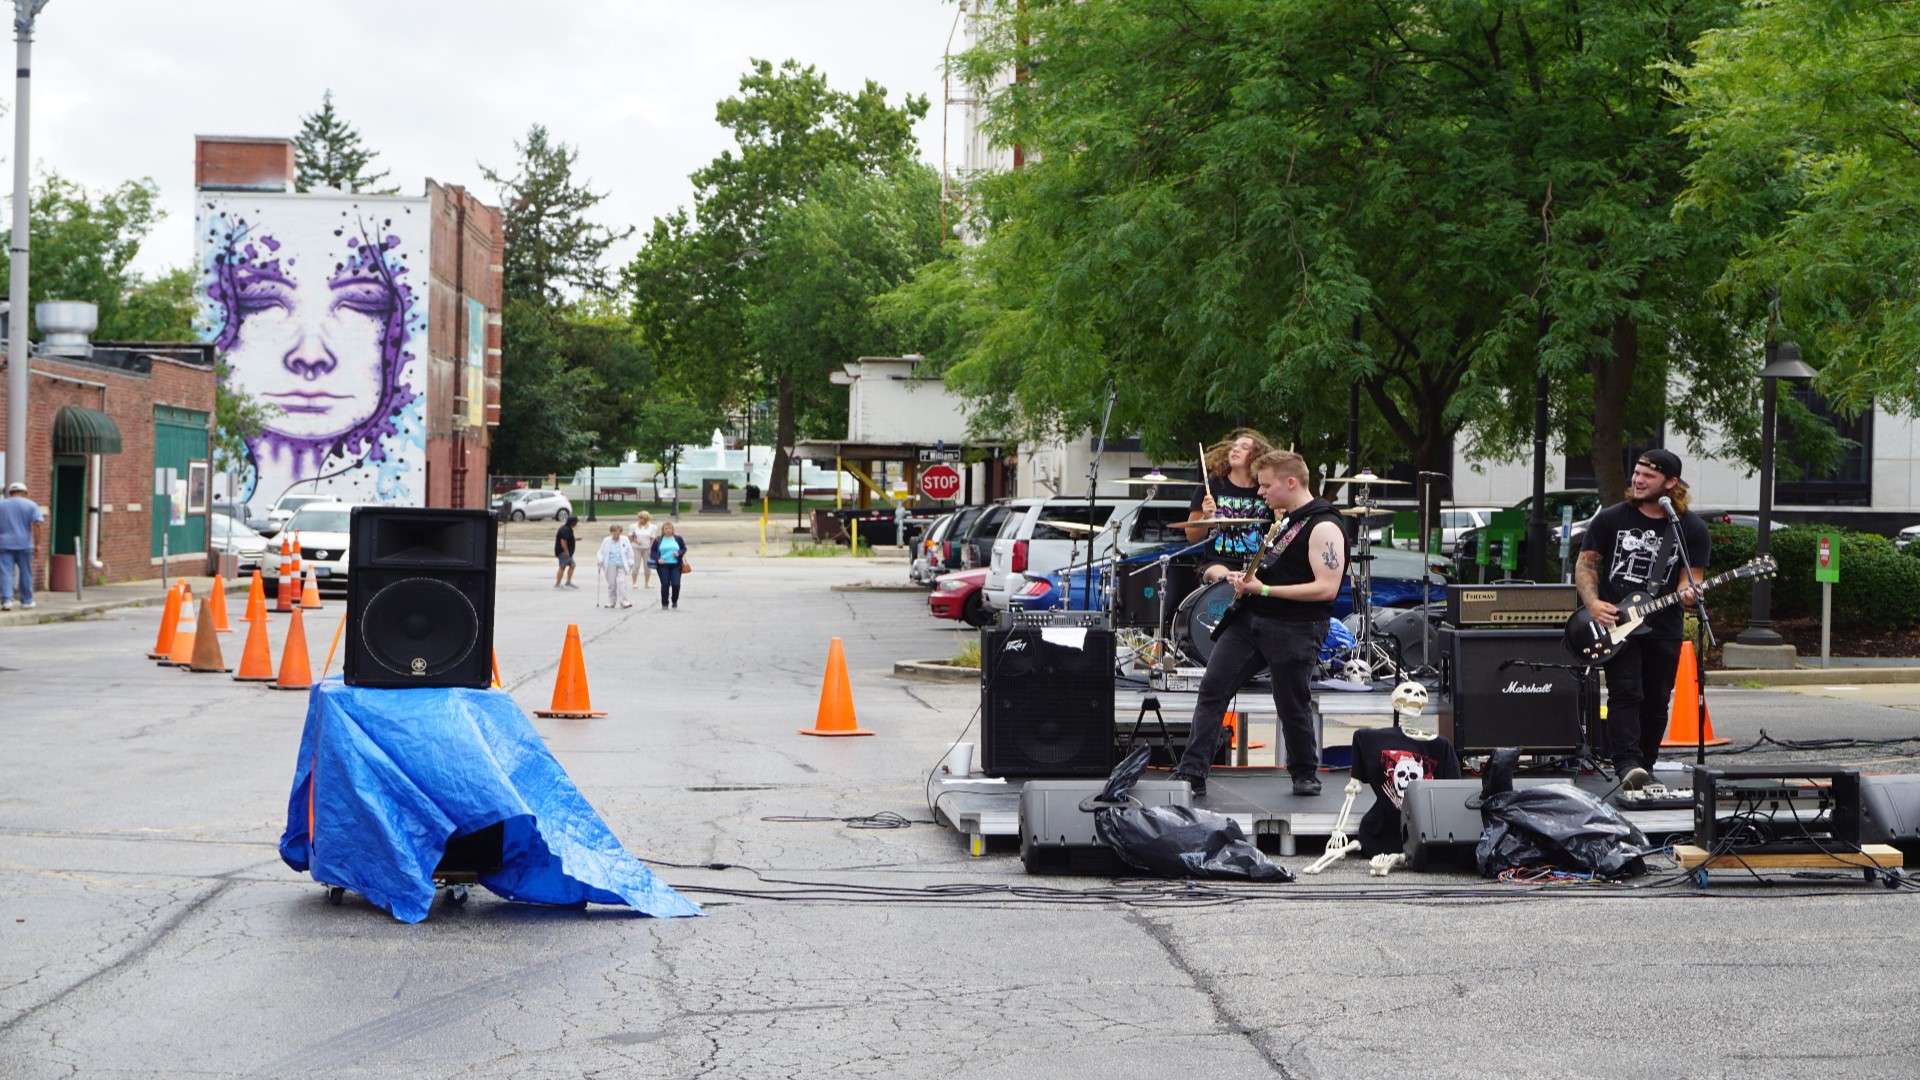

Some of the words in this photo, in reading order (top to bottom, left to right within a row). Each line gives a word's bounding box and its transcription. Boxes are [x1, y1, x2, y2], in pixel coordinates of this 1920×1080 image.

[930, 451, 954, 460] William
[924, 476, 958, 489] STOP
[1218, 495, 1267, 510] KISS
[1502, 681, 1552, 693] Marshall
